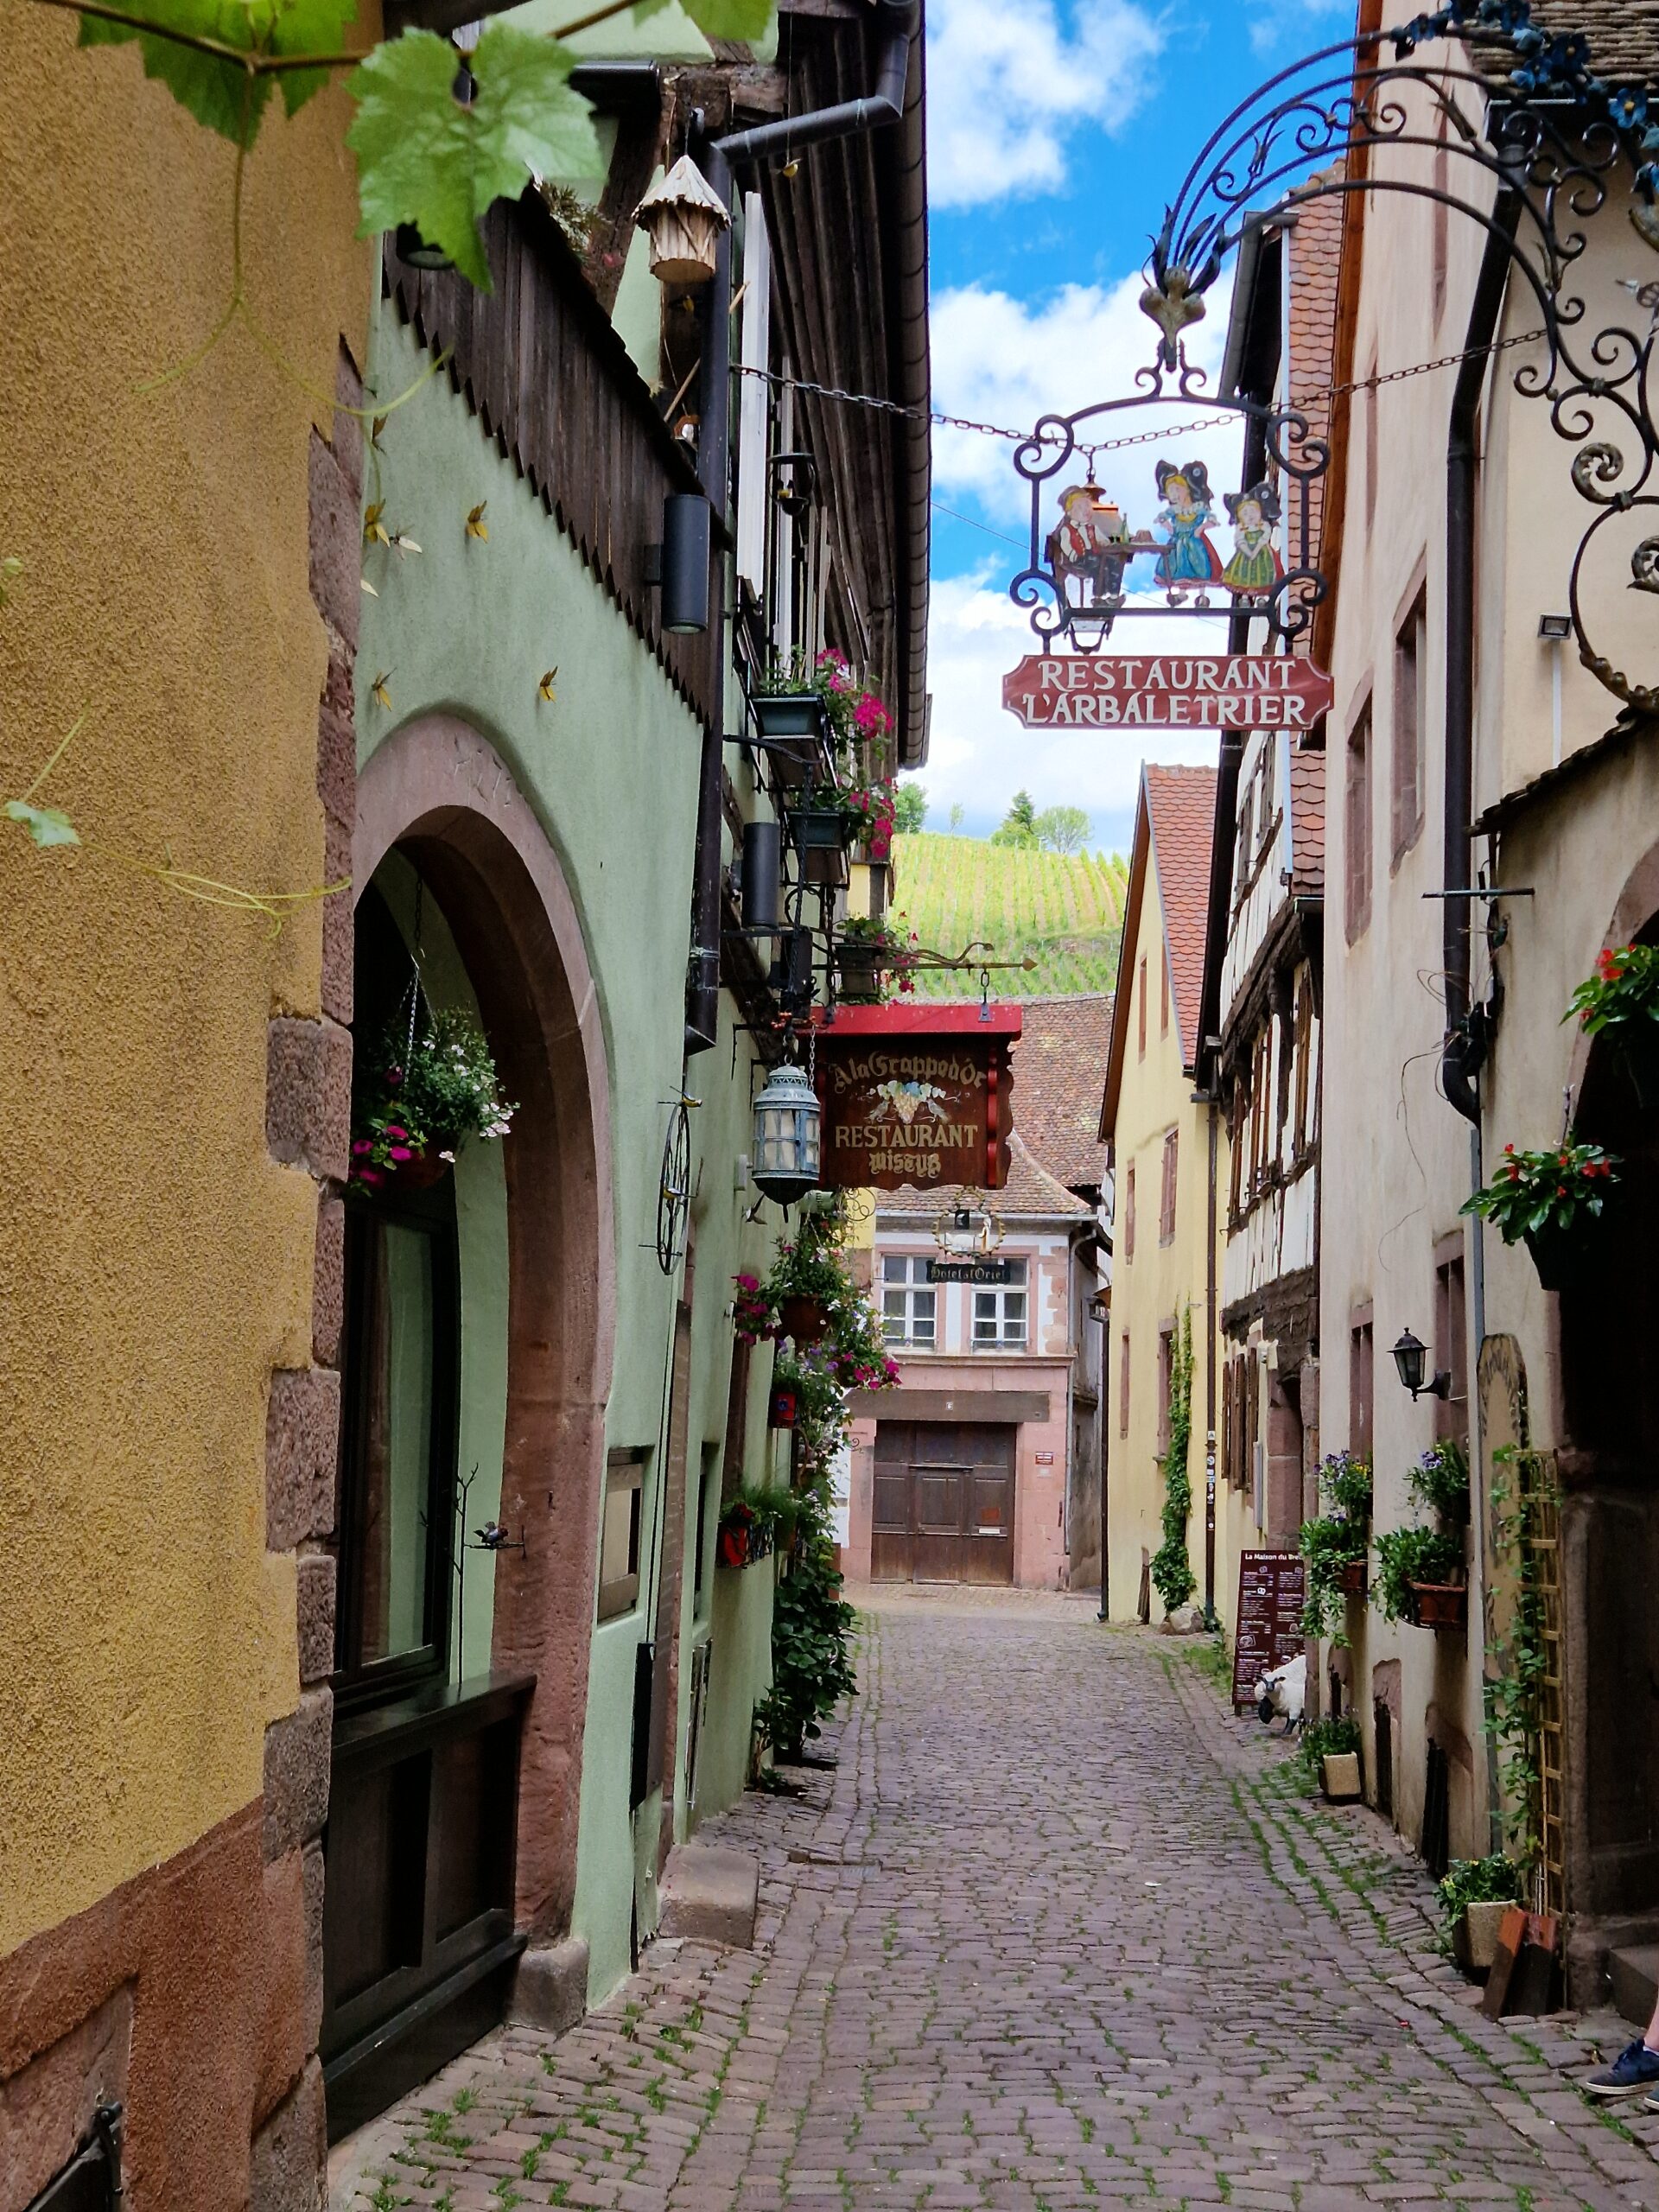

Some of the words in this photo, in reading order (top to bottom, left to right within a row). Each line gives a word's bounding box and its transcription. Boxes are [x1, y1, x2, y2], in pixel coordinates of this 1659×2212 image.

[1038, 658, 1296, 691] RESTAURANT
[1022, 691, 1312, 726] L'ARBALETRIER
[835, 1124, 978, 1148] RESTAURANT
